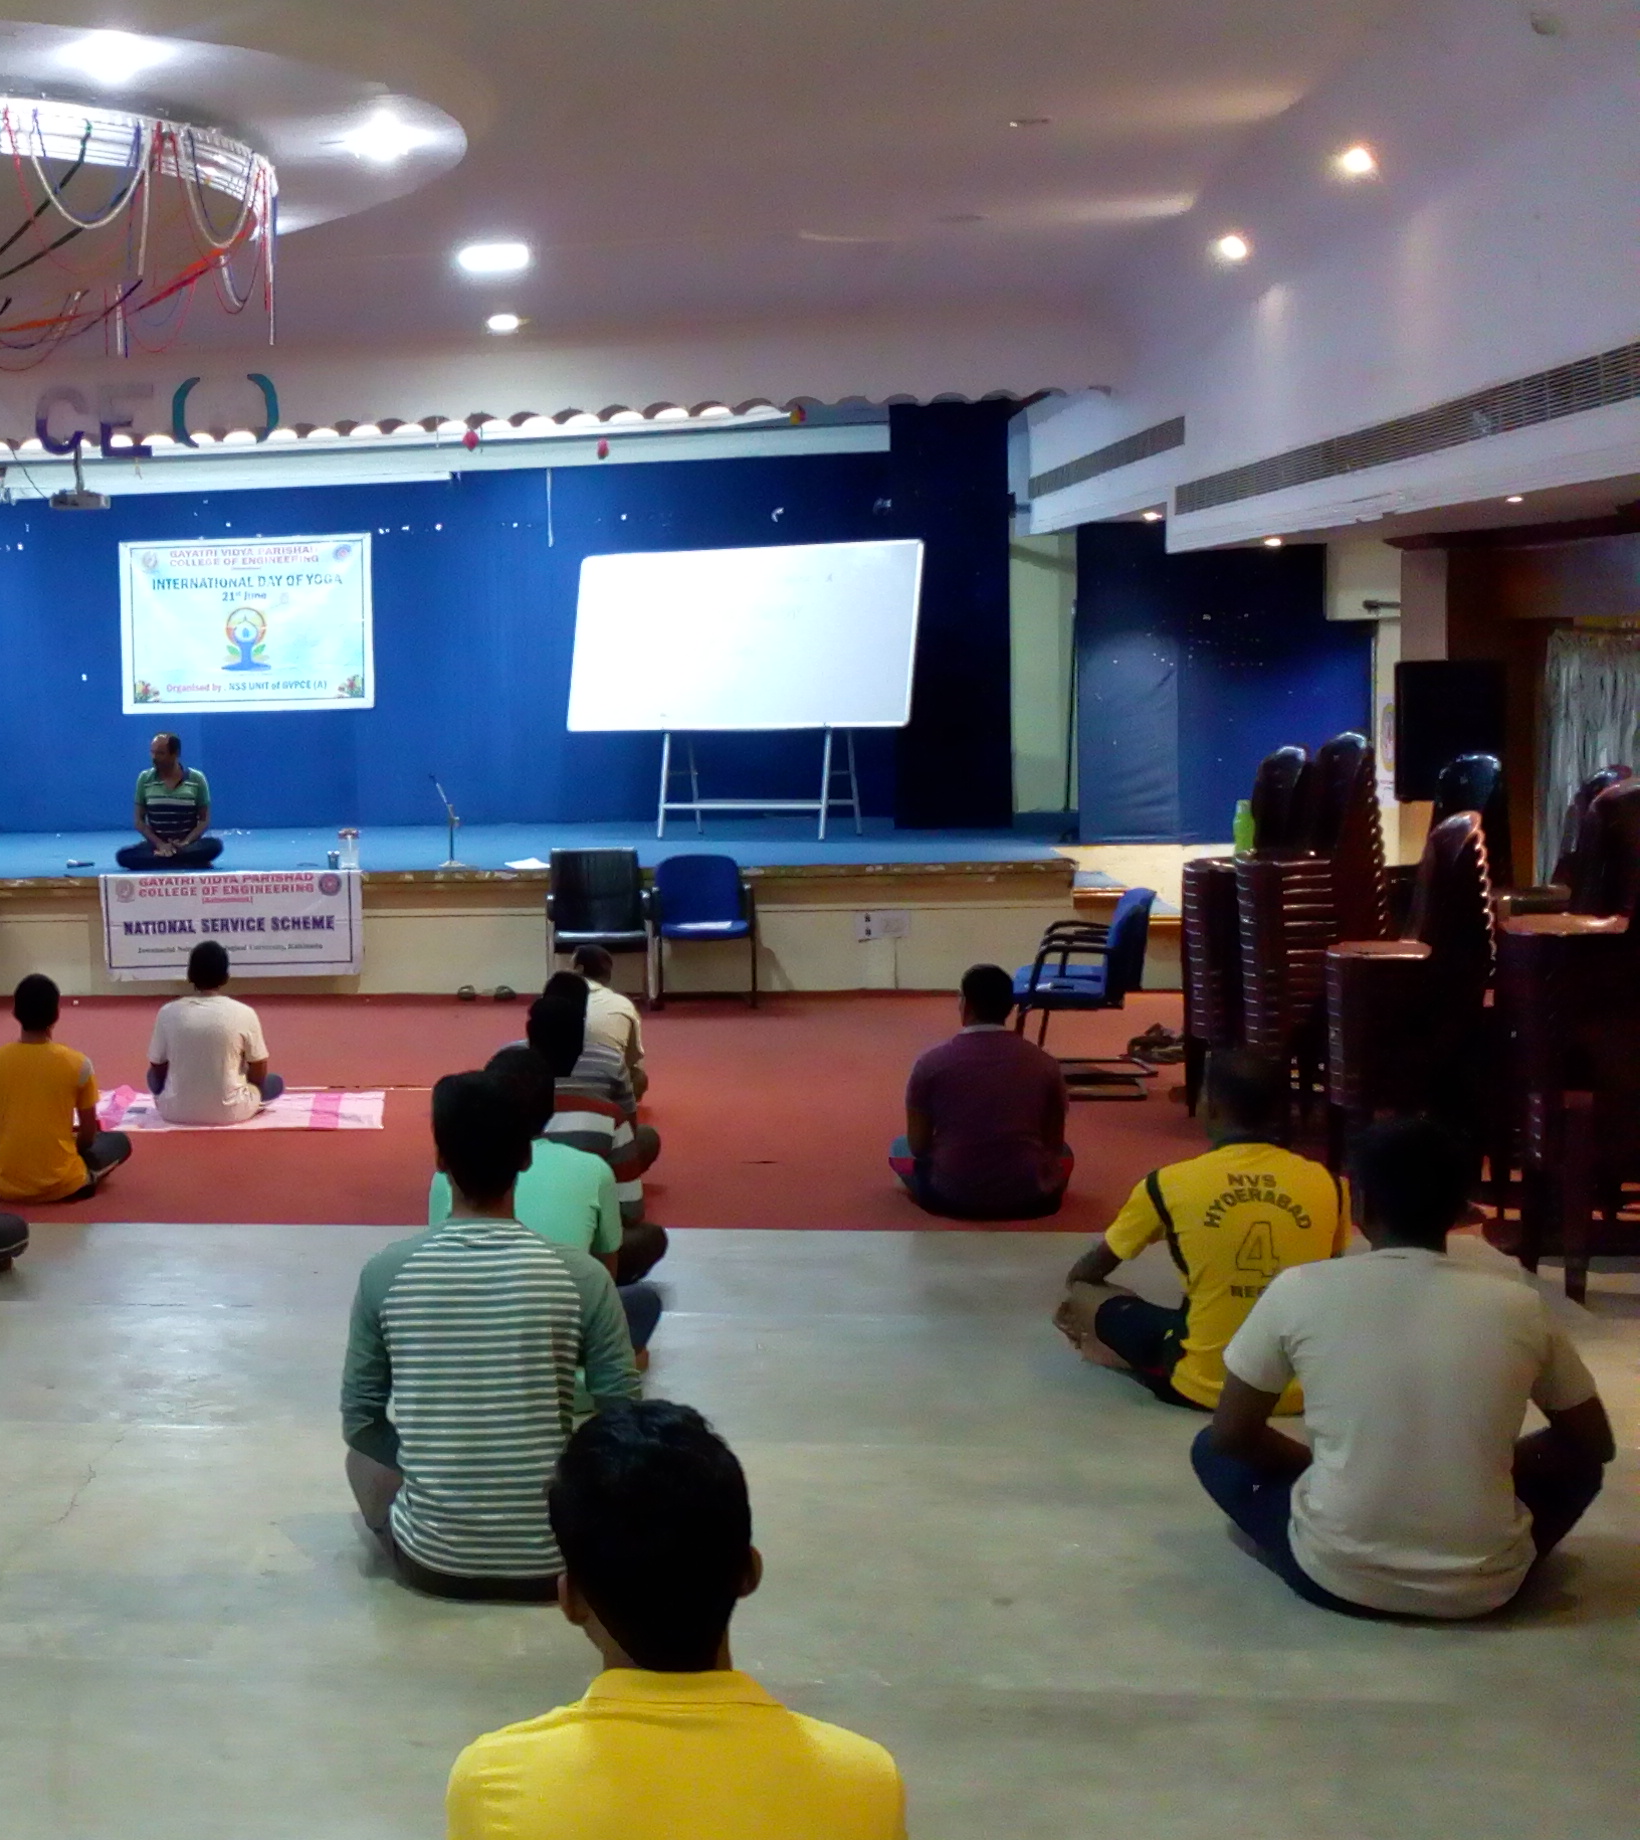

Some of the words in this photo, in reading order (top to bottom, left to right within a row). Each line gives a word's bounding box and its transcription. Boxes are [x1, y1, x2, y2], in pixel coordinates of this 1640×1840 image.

[221, 547, 254, 557] VIDYA
[169, 557, 220, 567] COLLEGE
[223, 557, 238, 566] OF
[152, 575, 254, 591] INTERNATIONAL
[258, 574, 283, 588] DAY
[286, 574, 304, 587] OF
[306, 573, 343, 586] YOGA
[229, 682, 247, 692] NSS
[249, 681, 269, 691] UNIT
[139, 876, 195, 887] GAYATRI
[199, 874, 238, 885] VIDYA
[242, 873, 314, 884] PARISHAD
[139, 886, 197, 898] COLLEGE
[202, 886, 219, 896] OF
[223, 883, 314, 895] ENGINEERING
[123, 919, 196, 935] NATIONAL
[201, 917, 265, 934] SERVICE
[271, 915, 335, 932] SCHEME
[1227, 1172, 1277, 1188] NVS
[1203, 1188, 1313, 1230] HYDERABAD
[1235, 1220, 1280, 1278] 4
